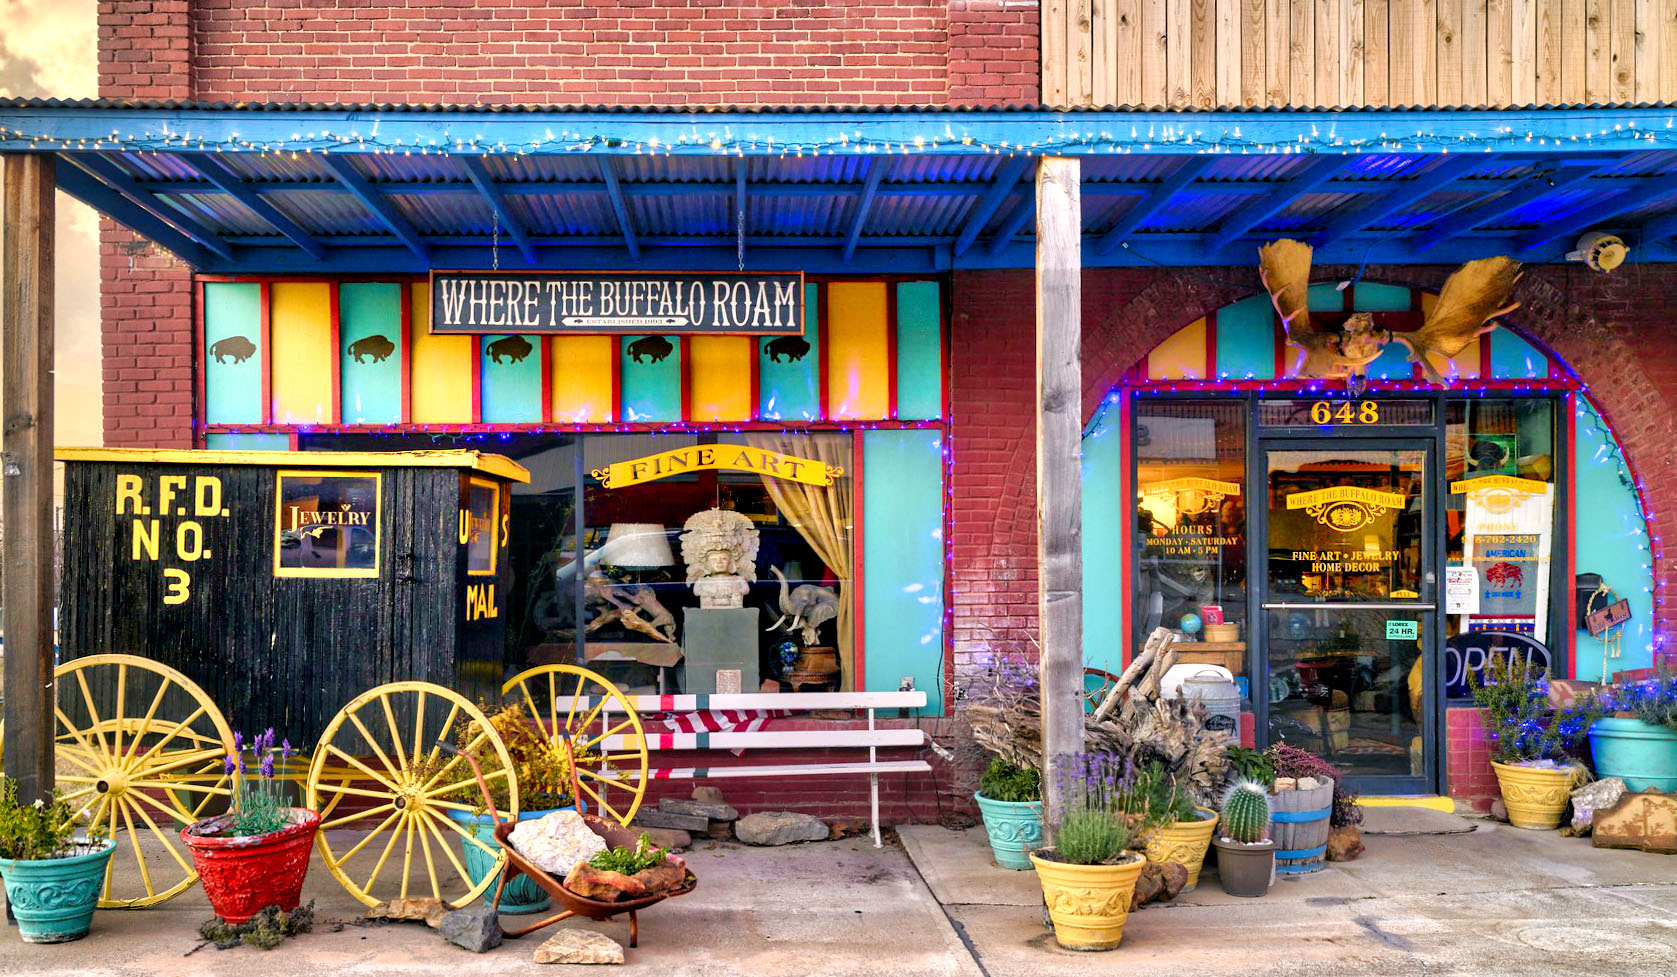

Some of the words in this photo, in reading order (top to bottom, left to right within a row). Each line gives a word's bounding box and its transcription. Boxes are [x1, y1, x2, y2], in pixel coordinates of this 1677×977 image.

[440, 279, 540, 326] WHERE
[546, 281, 593, 326] THE
[600, 281, 705, 327] BUFFALO
[713, 281, 796, 327] ROAM
[1311, 401, 1379, 424] 648
[630, 449, 716, 480] FINE
[733, 450, 806, 479] ART
[116, 474, 230, 517] R.F.D.
[1289, 493, 1318, 506] WHERE
[1322, 490, 1337, 501] THE
[1339, 488, 1377, 500] BUFFALO
[1380, 495, 1402, 506] ROAM
[288, 506, 371, 533] JEWELRY
[459, 509, 470, 545] U
[501, 514, 509, 548] S
[1172, 525, 1213, 535] HOURS
[1165, 546, 1175, 554] 10
[1178, 546, 1191, 554] AM
[1205, 546, 1218, 554] PM
[1461, 535, 1537, 544] 98-762-2420
[1292, 551, 1316, 561] FINE
[1319, 551, 1341, 561] ART
[1351, 551, 1399, 561] JEWELRY
[1486, 550, 1526, 558] AMERICAN
[1312, 562, 1341, 572] HOME
[1345, 562, 1380, 572] DECOR
[163, 569, 190, 605] 3
[466, 583, 499, 621] MAIL
